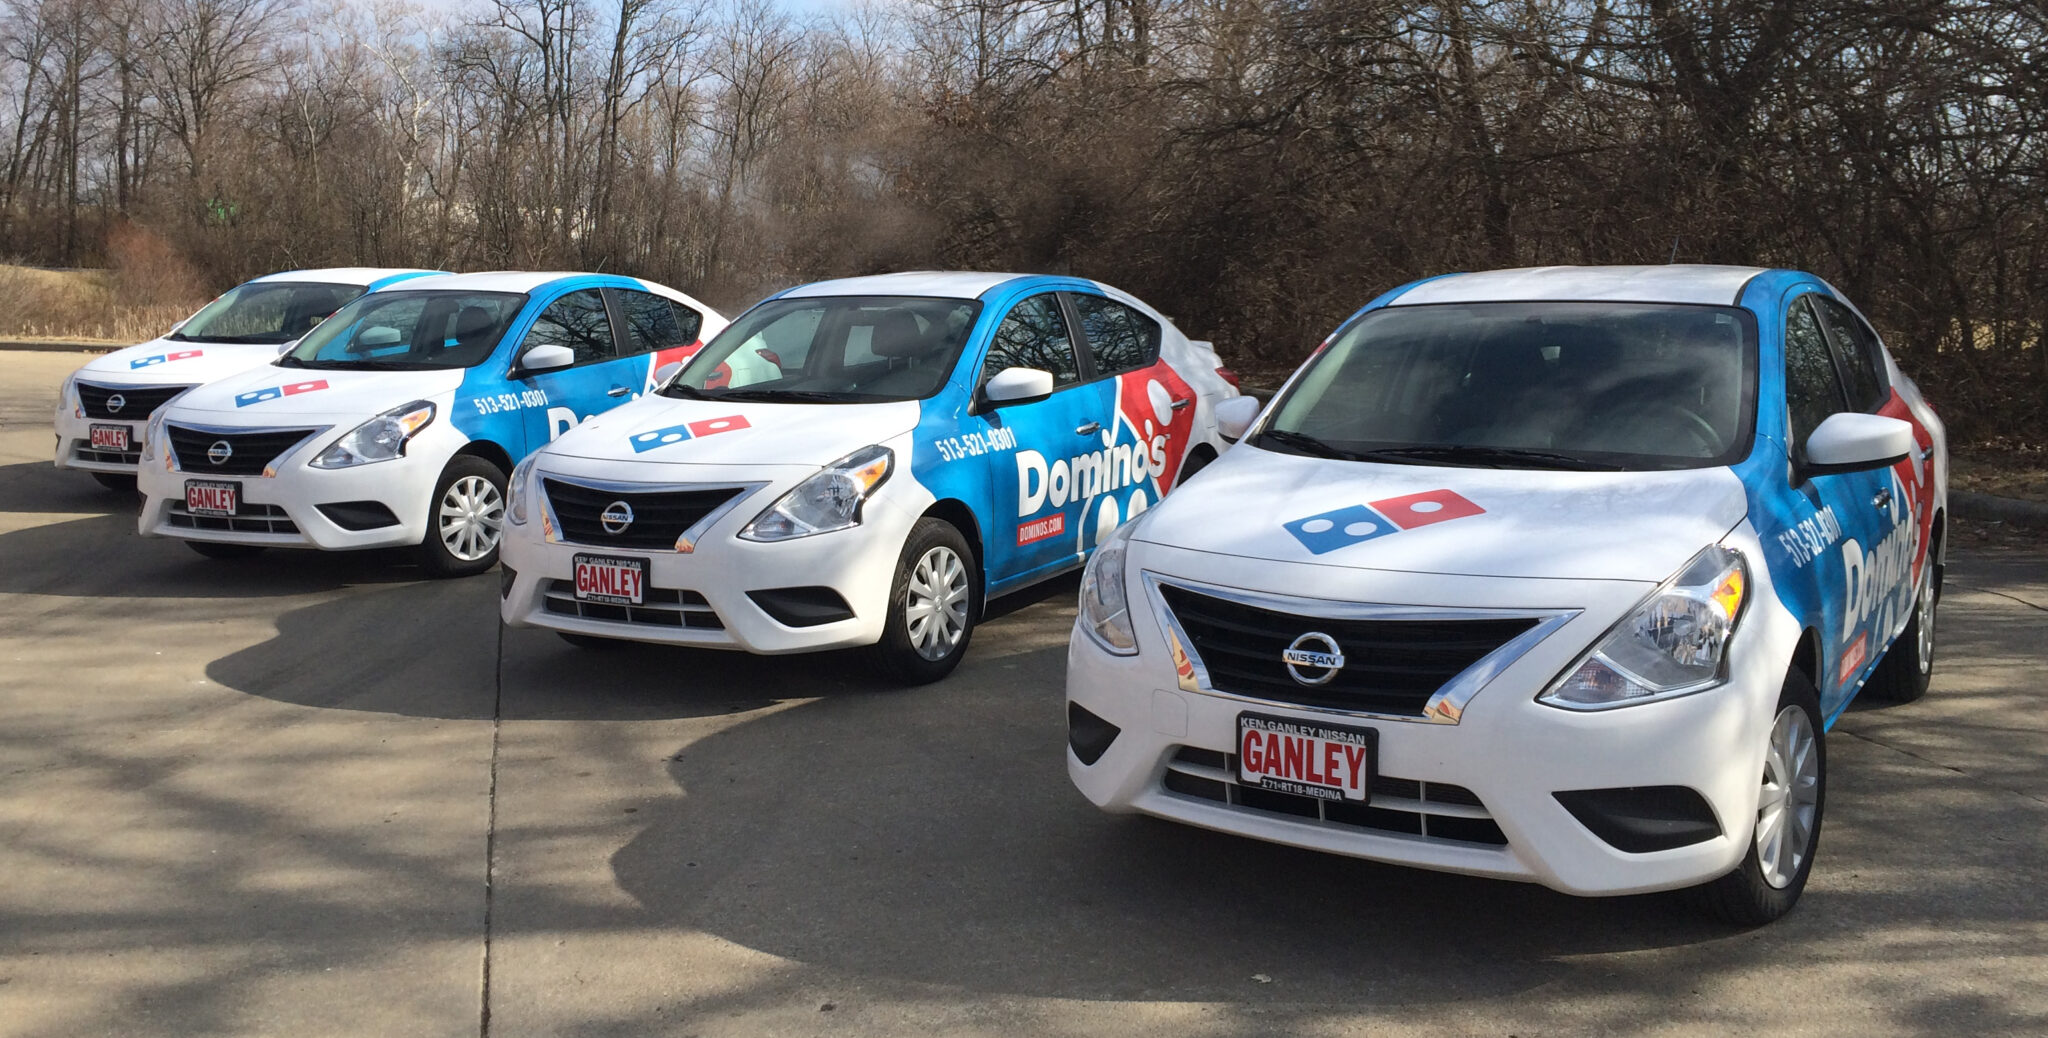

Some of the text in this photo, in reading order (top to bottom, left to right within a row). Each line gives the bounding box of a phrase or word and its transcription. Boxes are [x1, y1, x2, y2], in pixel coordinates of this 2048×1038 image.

[473, 389, 549, 415] 513-521-0301
[91, 429, 128, 448] GANLEY
[934, 426, 1017, 462] 513-521-0301
[1015, 418, 1167, 518] Domino's
[188, 487, 236, 511] GANLEY
[601, 513, 630, 522] NISSAN
[1019, 516, 1062, 542] DOMINOS.COM
[1778, 504, 1843, 569] 513-521-0301
[1841, 479, 1921, 644] Domino's
[577, 564, 642, 597] GANLEY
[1286, 651, 1337, 667] NISSAN
[1267, 720, 1317, 738] GANLEY
[1318, 728, 1366, 746] NISSAN
[1243, 729, 1367, 790] GANLEY
